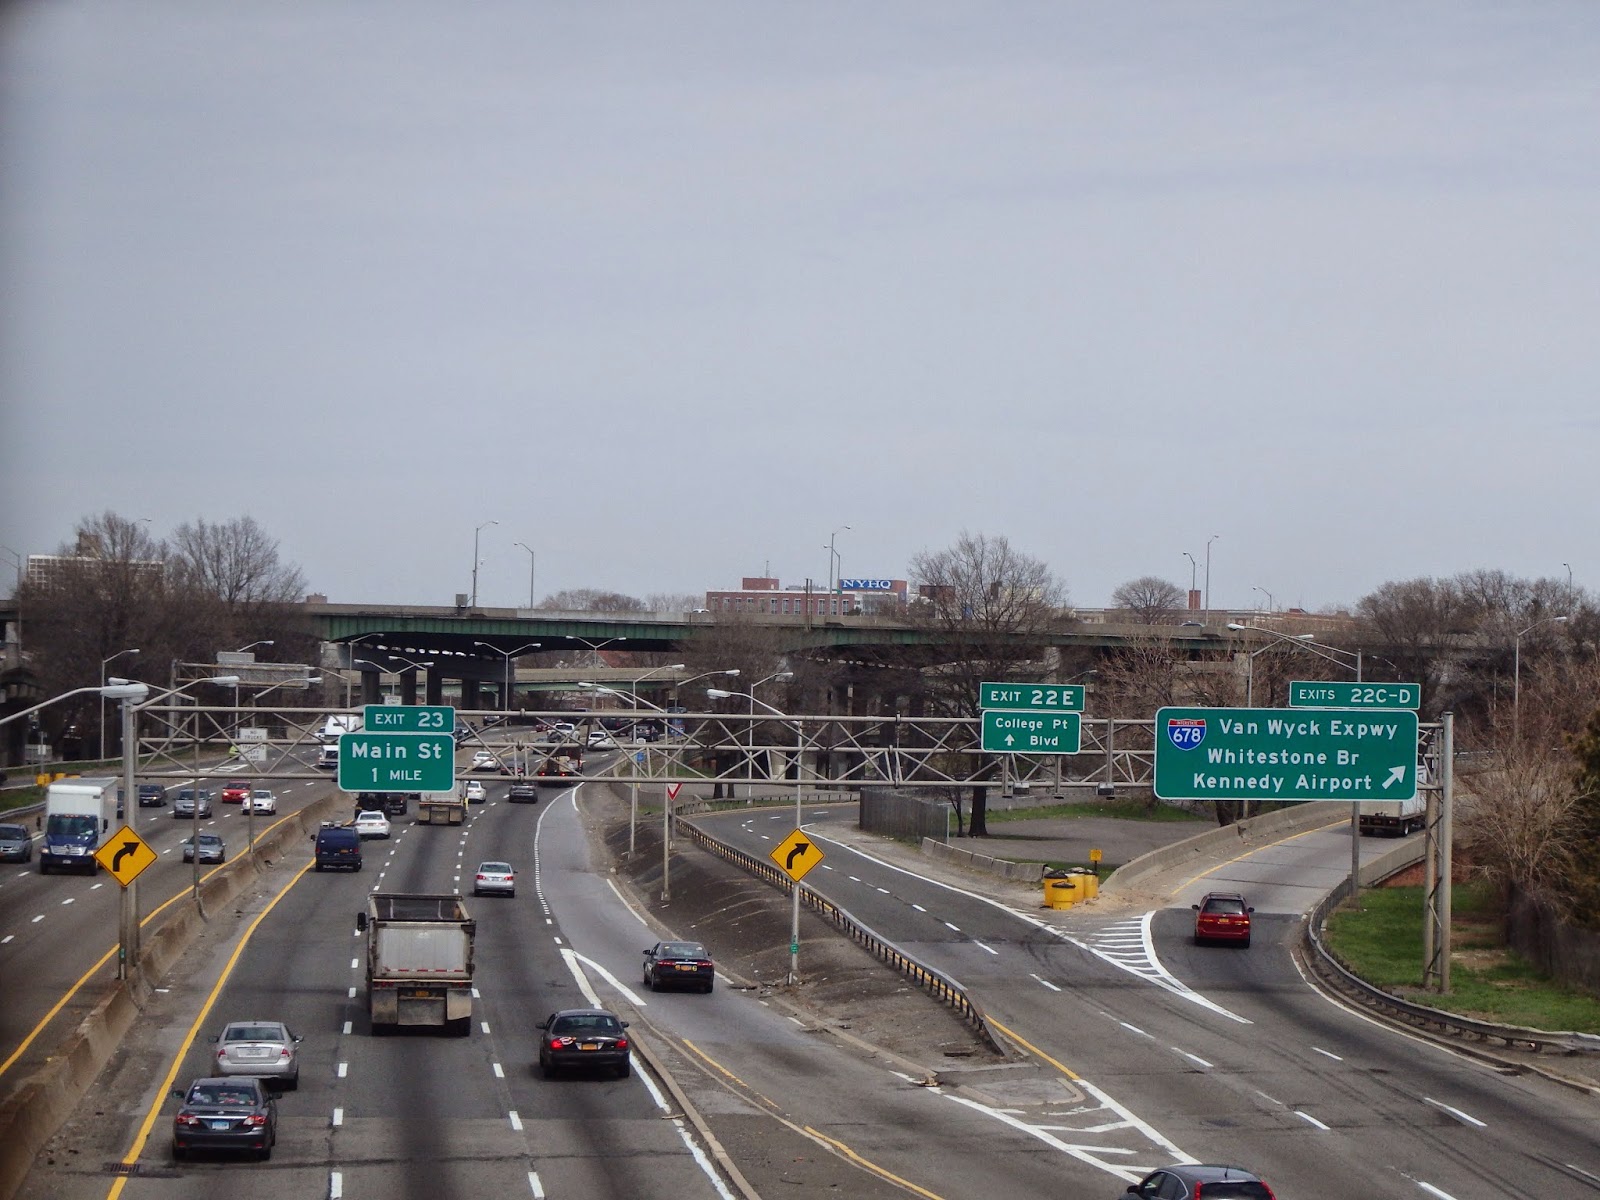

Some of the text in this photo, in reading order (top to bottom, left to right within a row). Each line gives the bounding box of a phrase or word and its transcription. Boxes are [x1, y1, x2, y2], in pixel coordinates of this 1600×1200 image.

[842, 580, 891, 589] NYHQ
[991, 689, 1074, 705] EXIT 22E
[1299, 688, 1411, 704] EXITS 22C-D
[375, 711, 444, 727] EXIT 23
[995, 717, 1068, 731] College Pt
[1173, 728, 1201, 742] 678
[1219, 719, 1398, 740] Van Wyck Expwy
[1030, 735, 1059, 746] Blvd
[352, 742, 442, 759] Main St
[1207, 748, 1360, 765] Whitestone Br
[371, 767, 422, 782] 1 MILE
[1193, 773, 1372, 793] Kennedy Airport
